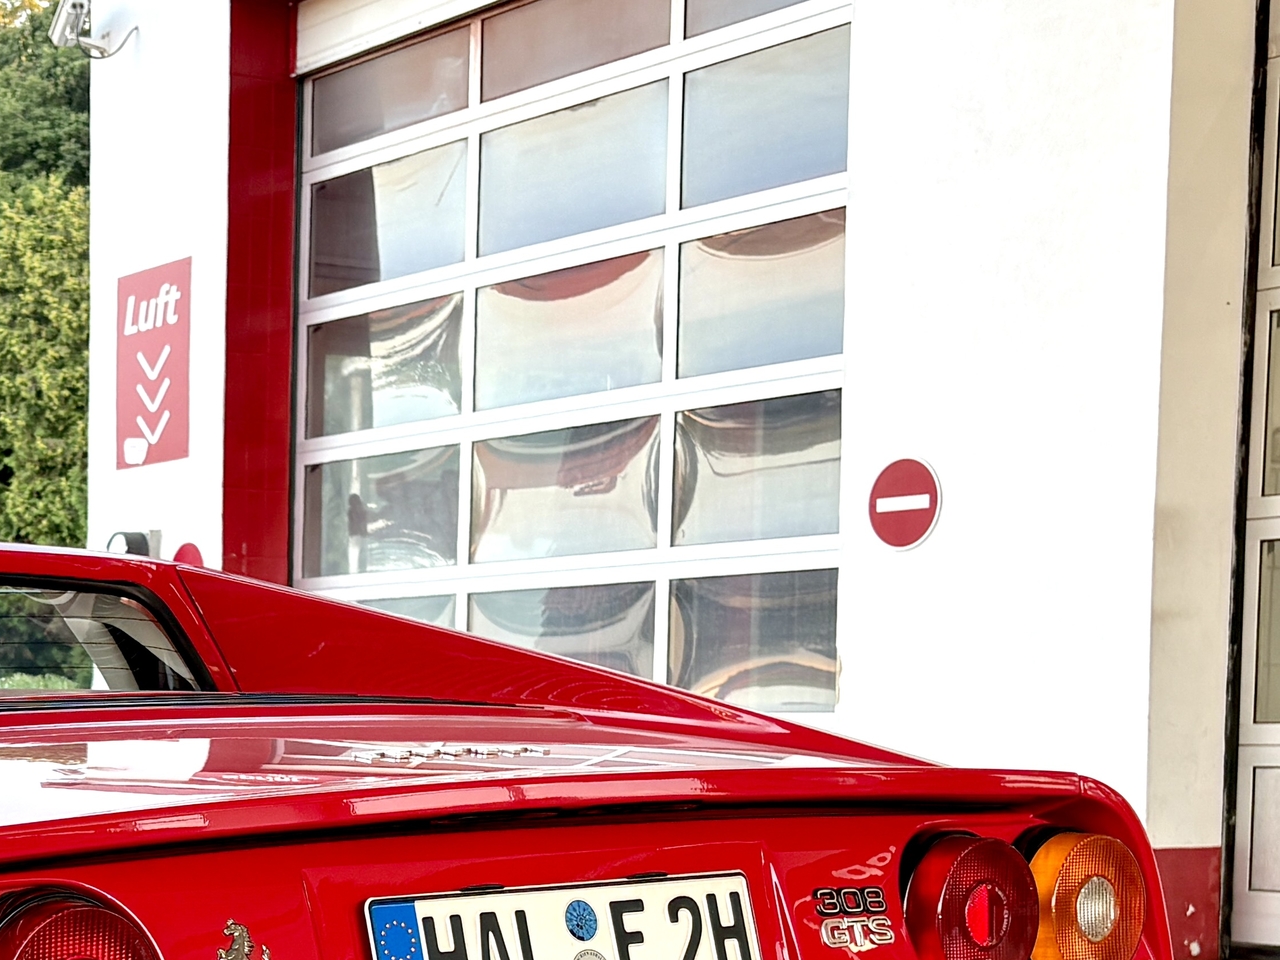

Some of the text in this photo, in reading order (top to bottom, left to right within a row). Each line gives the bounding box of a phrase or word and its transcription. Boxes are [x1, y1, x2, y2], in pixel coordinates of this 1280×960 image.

[123, 283, 182, 336] Luft
[813, 887, 888, 916] 308
[821, 916, 895, 948] GTS
